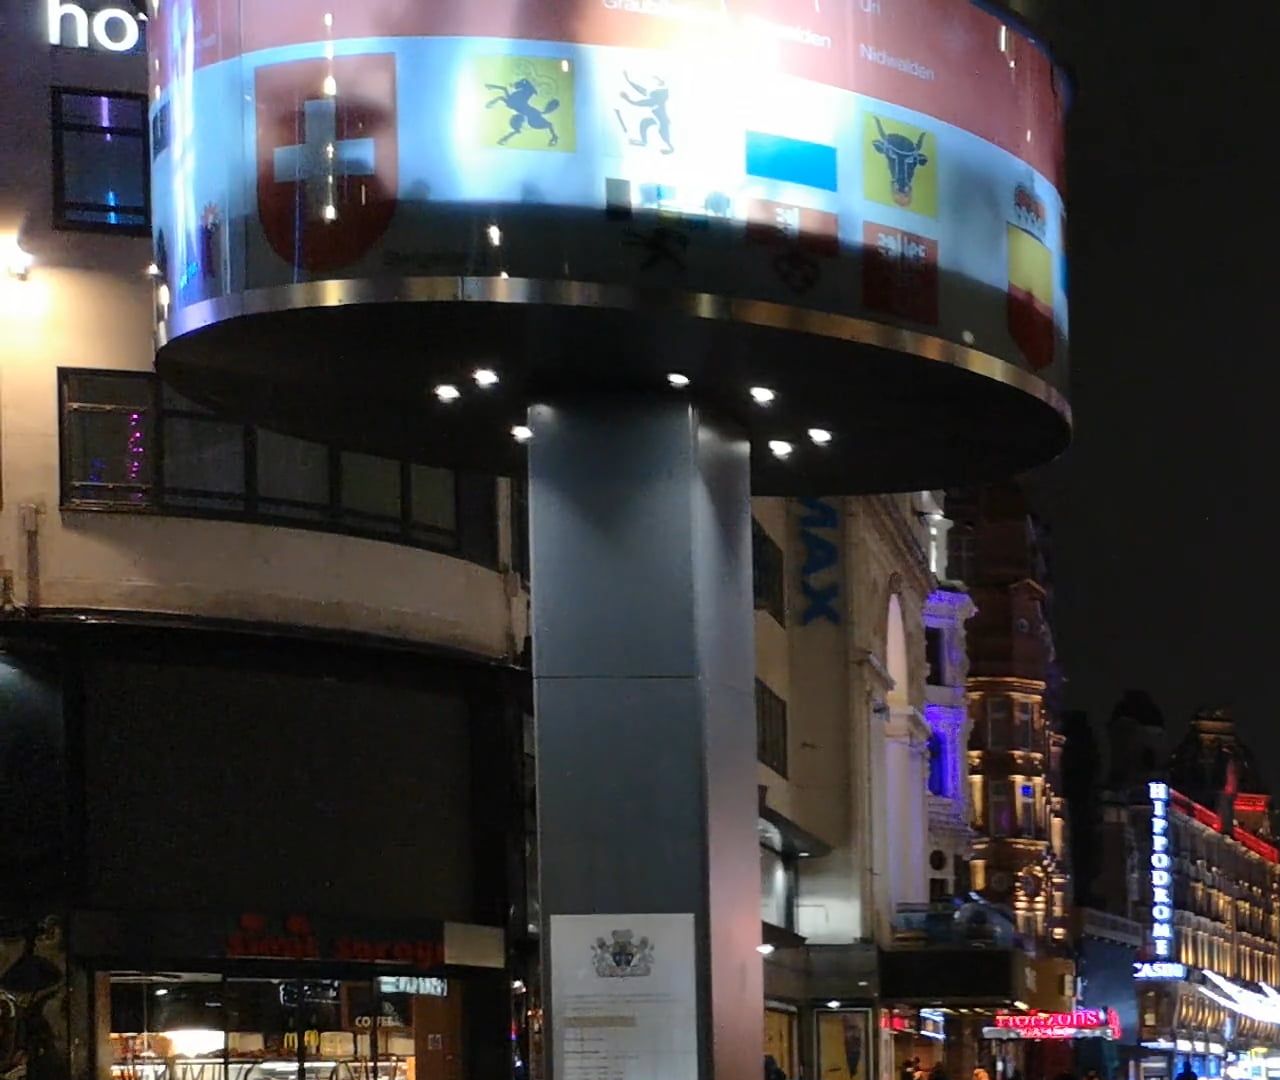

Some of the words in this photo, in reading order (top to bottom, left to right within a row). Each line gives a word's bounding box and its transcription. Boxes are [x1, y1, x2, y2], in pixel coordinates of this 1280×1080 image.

[48, 0, 148, 51] ho
[859, 43, 936, 81] Nidwalden
[1149, 782, 1173, 956] HIPPODROME
[355, 1016, 393, 1028] COFEE
